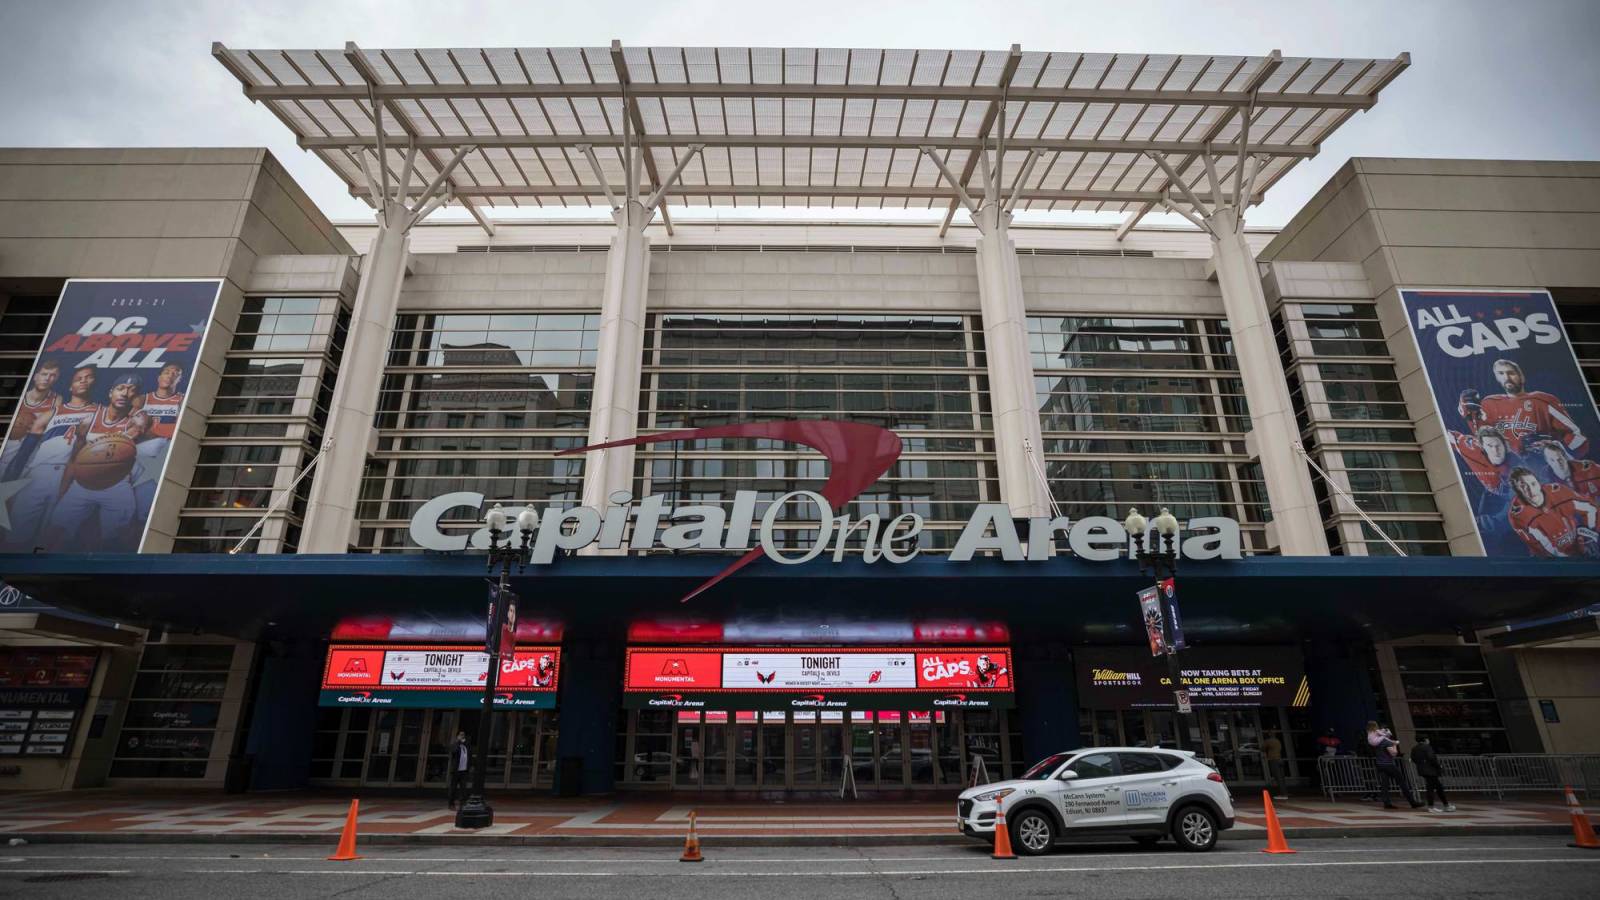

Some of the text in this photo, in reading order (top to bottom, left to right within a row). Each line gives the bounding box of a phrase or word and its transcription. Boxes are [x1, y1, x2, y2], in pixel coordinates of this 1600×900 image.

[1417, 304, 1472, 330] ALL
[76, 316, 149, 336] DC
[48, 332, 200, 352] ABOVE
[1436, 312, 1562, 359] CAPS
[73, 347, 170, 369] ALL
[947, 502, 1244, 562] Arena
[424, 653, 465, 666] TONIGHT
[502, 658, 535, 674] CAPS
[800, 657, 841, 669] TONIGHT
[922, 656, 944, 668] ALL
[922, 660, 970, 681] CAPS
[1092, 668, 1142, 681] William HILL
[1180, 669, 1262, 677] NOW TAKING BETS AT
[1193, 677, 1210, 685] ONE
[1211, 677, 1239, 685] ARENA
[1239, 677, 1256, 685] BOX
[1257, 676, 1285, 684] OFFICE
[1085, 792, 1106, 800] Systems
